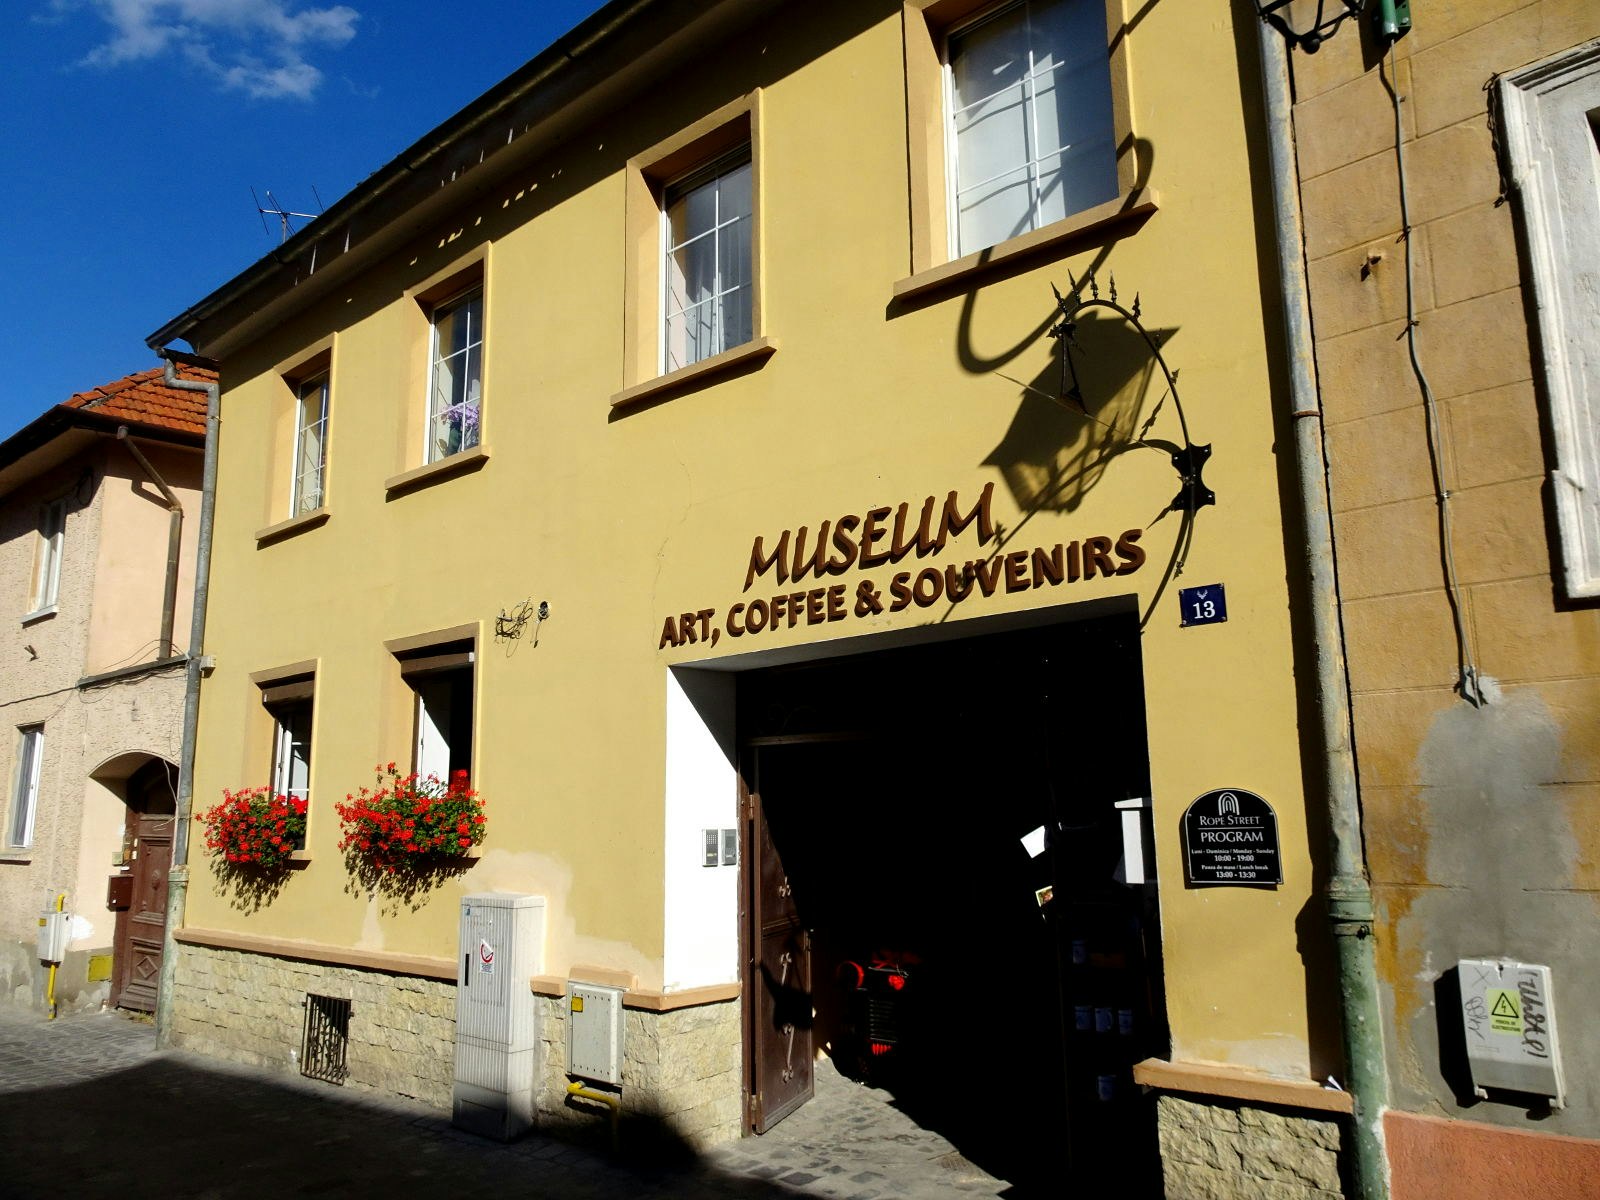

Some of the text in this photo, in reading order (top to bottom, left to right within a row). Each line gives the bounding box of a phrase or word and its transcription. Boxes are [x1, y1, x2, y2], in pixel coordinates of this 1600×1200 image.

[742, 481, 995, 593] MUSEUM
[659, 528, 1147, 650] ART, COFFEE & SOUVENIRS
[1192, 600, 1216, 619] 13
[1199, 815, 1261, 826] ROPE STREET
[1200, 831, 1264, 843] PROGRAM
[1215, 871, 1233, 879] 13:00
[1238, 871, 1256, 879] 13:30
